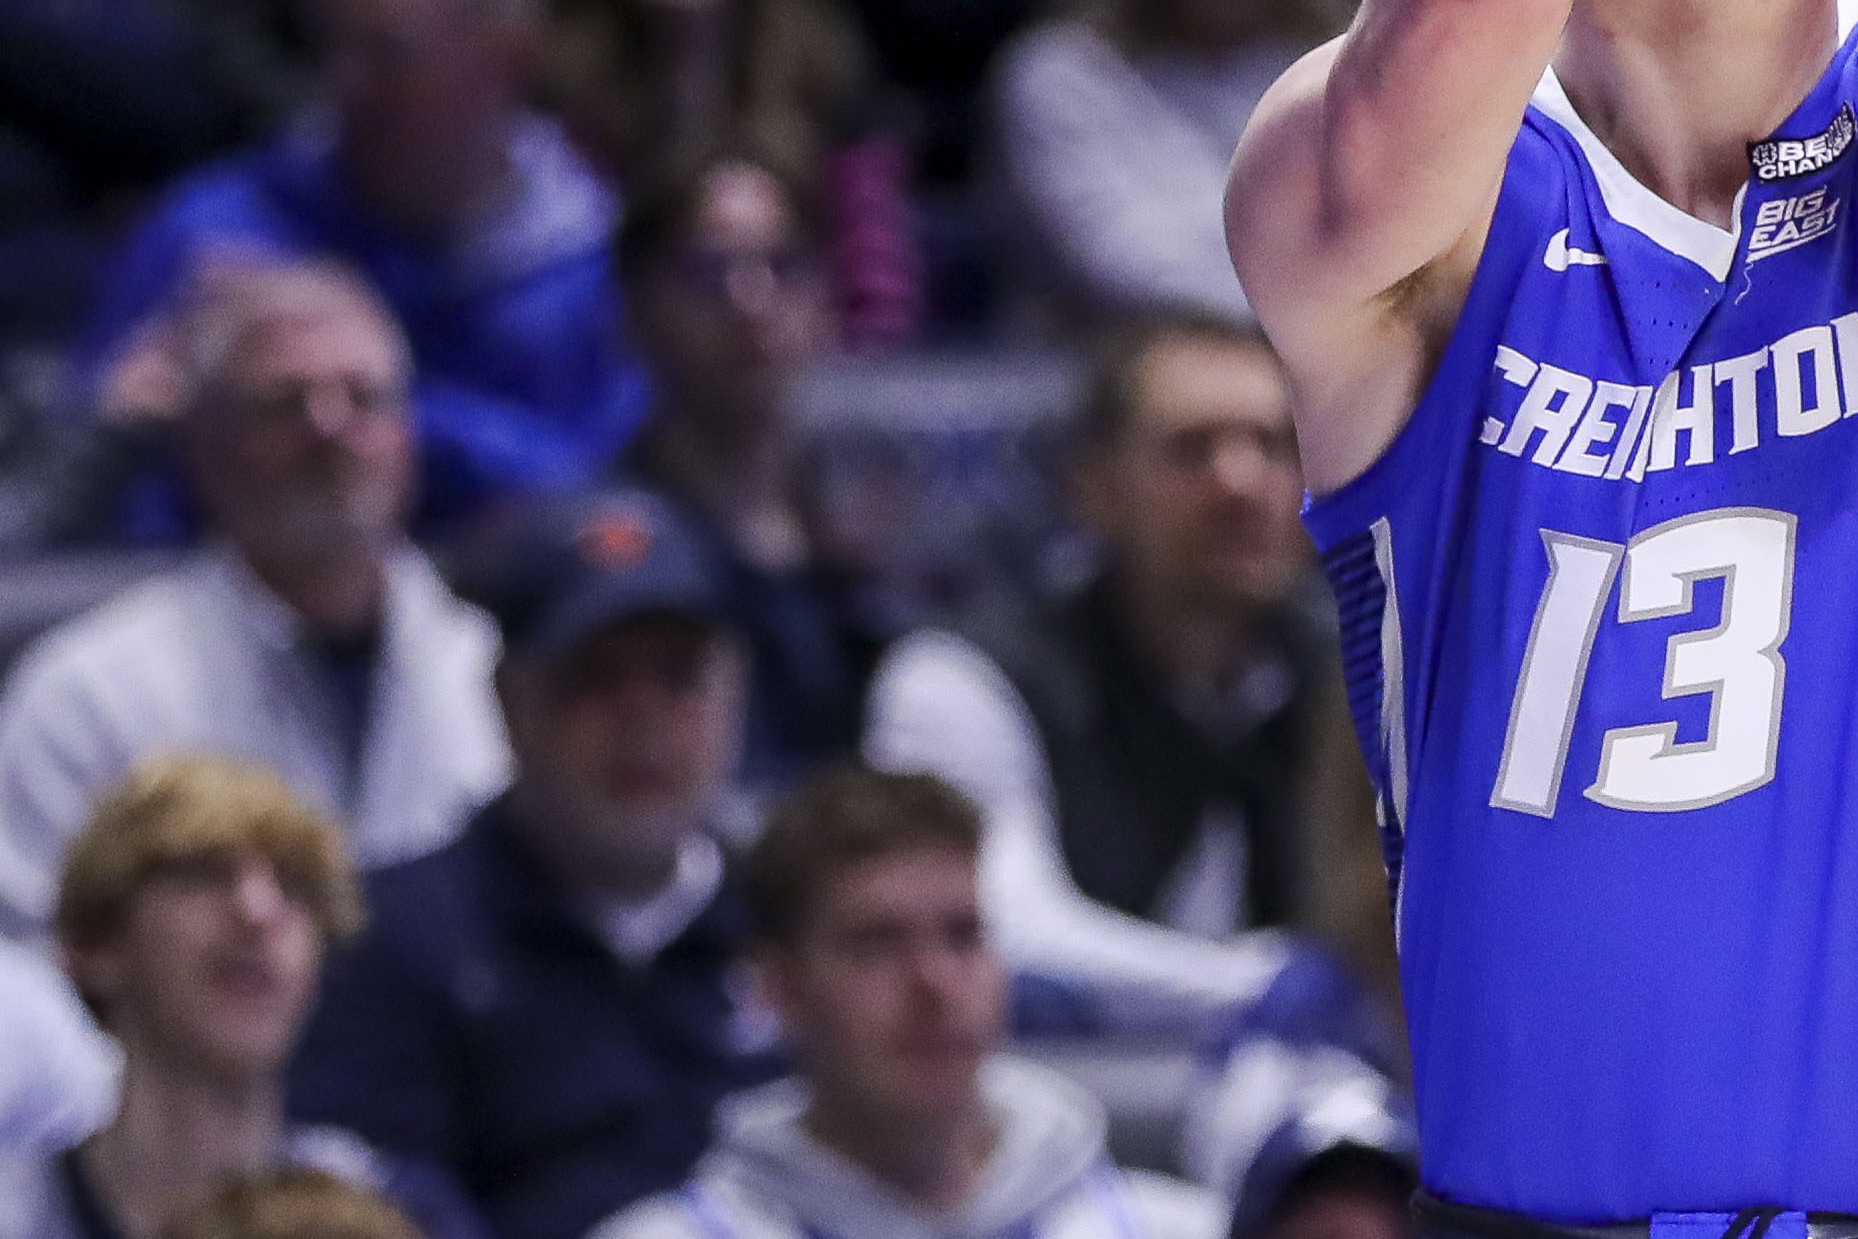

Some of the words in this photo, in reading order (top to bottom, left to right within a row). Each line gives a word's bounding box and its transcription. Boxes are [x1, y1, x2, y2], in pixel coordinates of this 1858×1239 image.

[1748, 197, 1841, 250] EAST
[1755, 185, 1828, 226] BIG
[1488, 506, 1799, 819] 13
